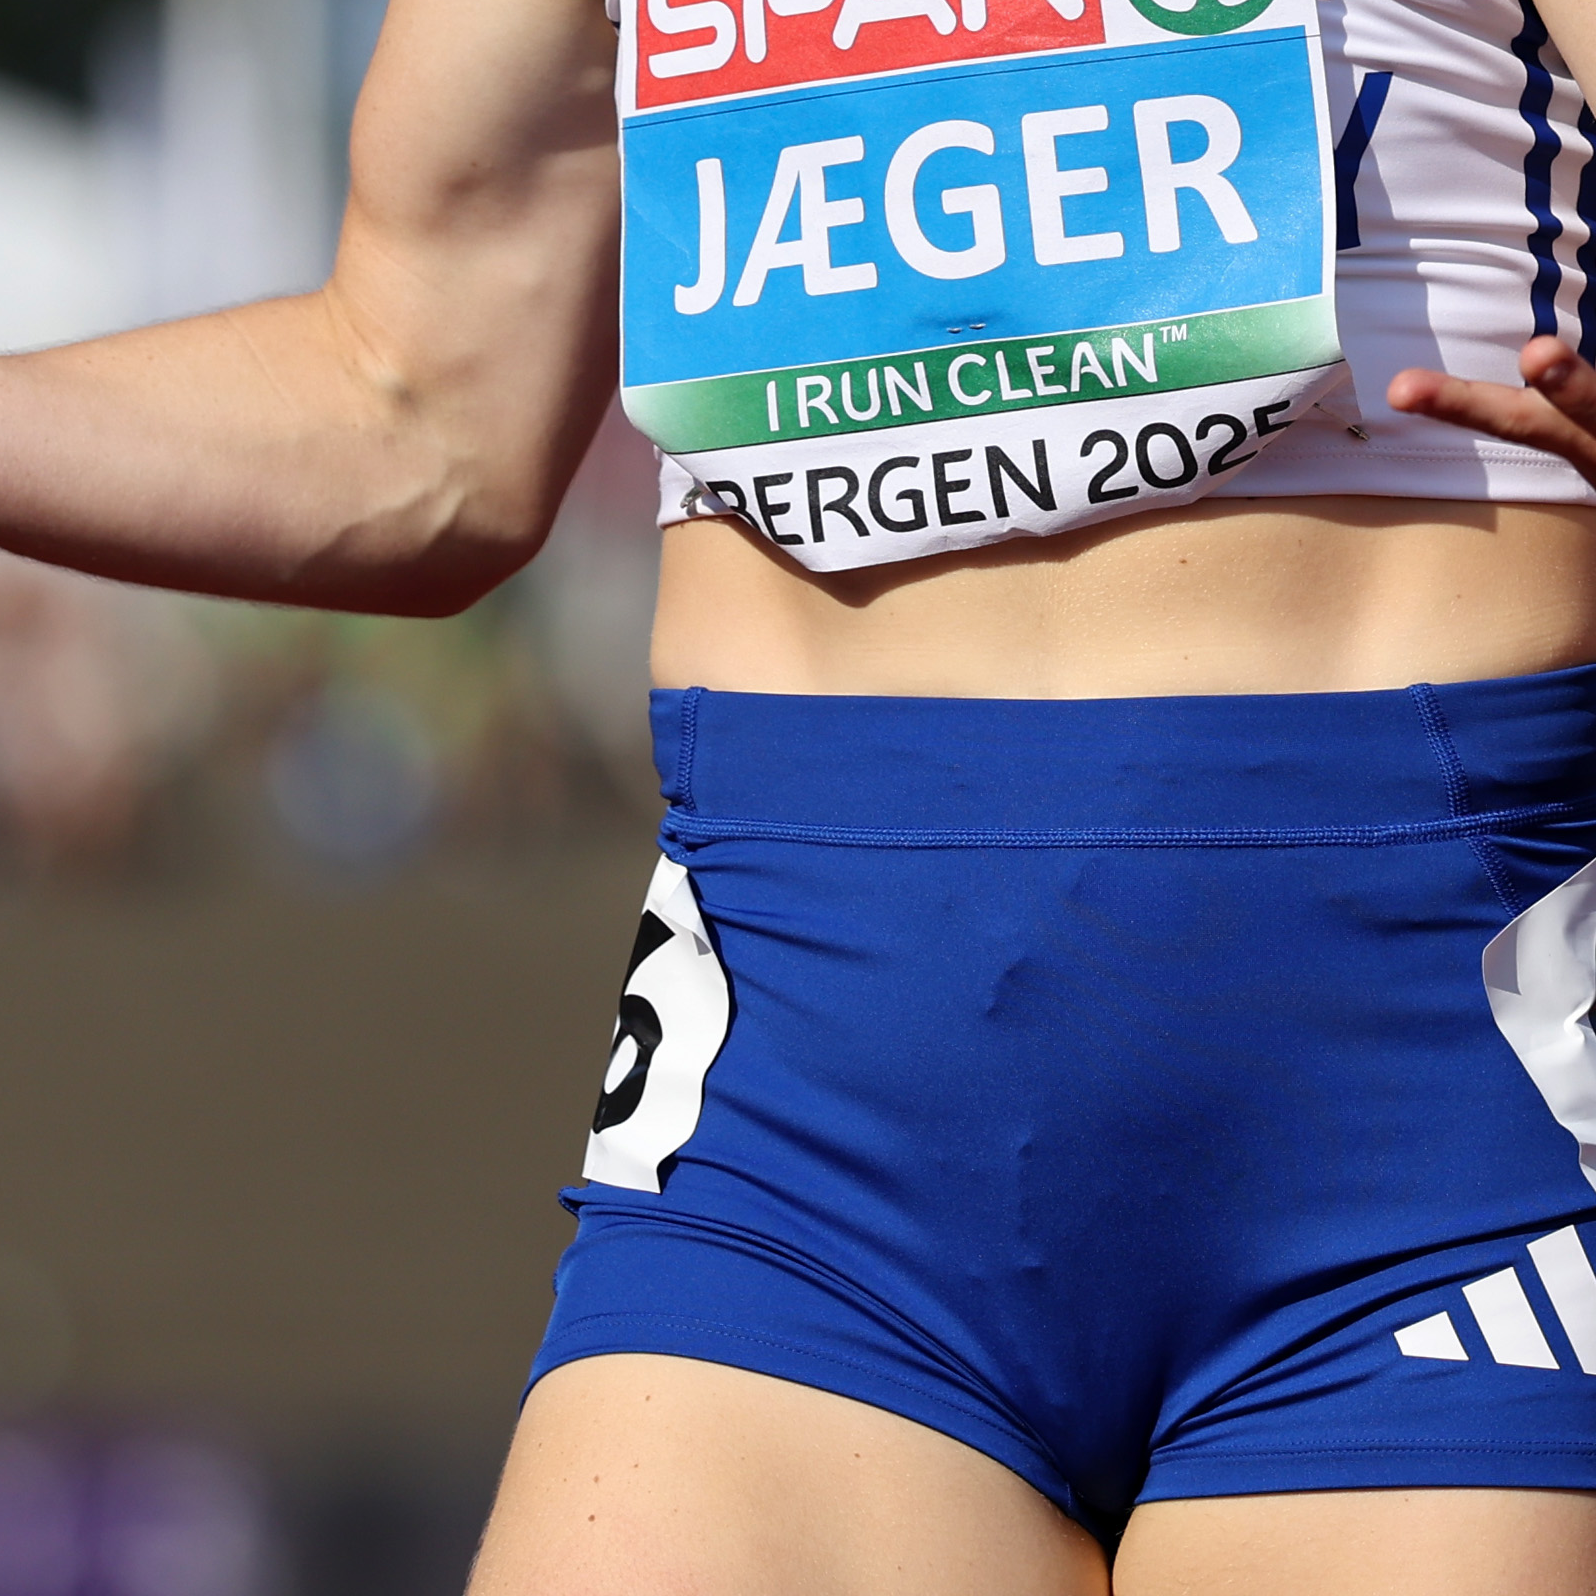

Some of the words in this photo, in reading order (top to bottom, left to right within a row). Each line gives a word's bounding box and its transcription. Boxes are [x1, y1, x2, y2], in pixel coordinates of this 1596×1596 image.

[674, 93, 1259, 316] JÆGER
[765, 380, 781, 433] I
[797, 360, 931, 429] RUN
